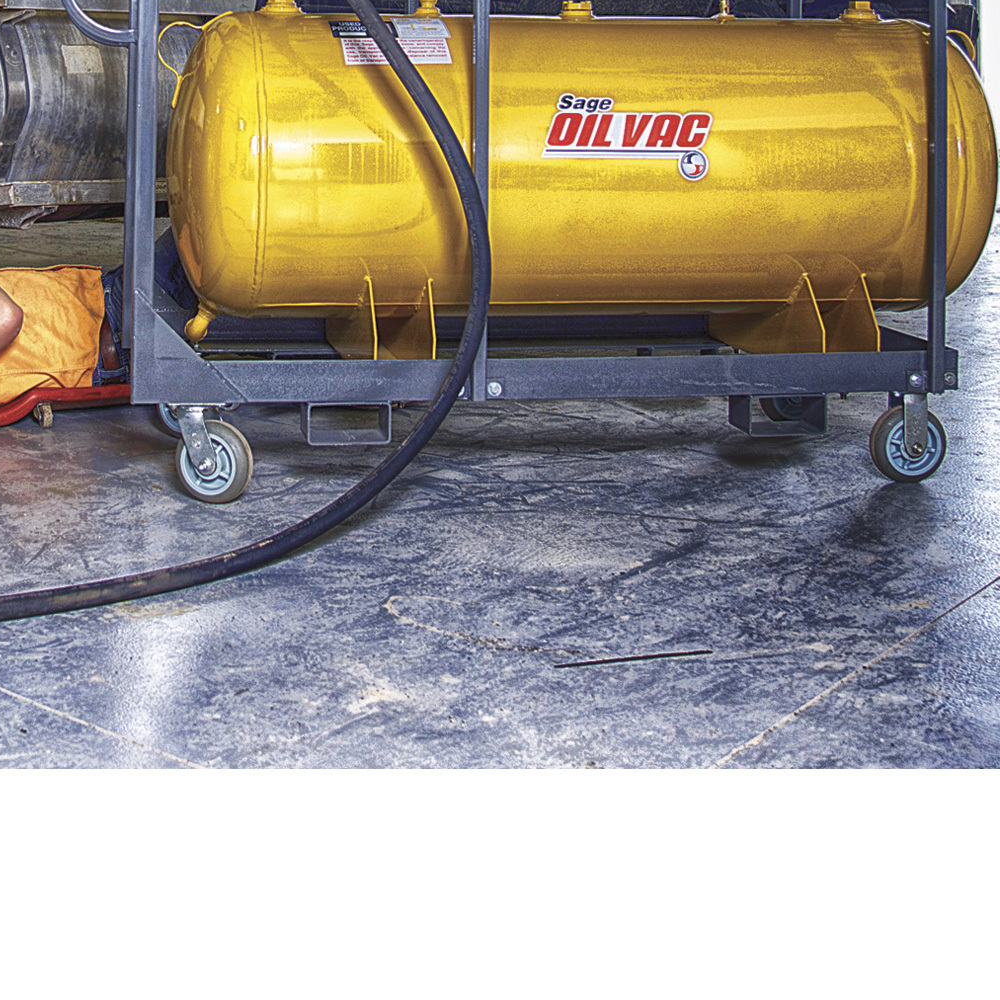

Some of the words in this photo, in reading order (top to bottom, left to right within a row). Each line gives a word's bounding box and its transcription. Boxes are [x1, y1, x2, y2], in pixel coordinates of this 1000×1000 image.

[558, 94, 612, 113] Sage
[547, 112, 614, 147] OIL
[622, 113, 711, 148] VAC
